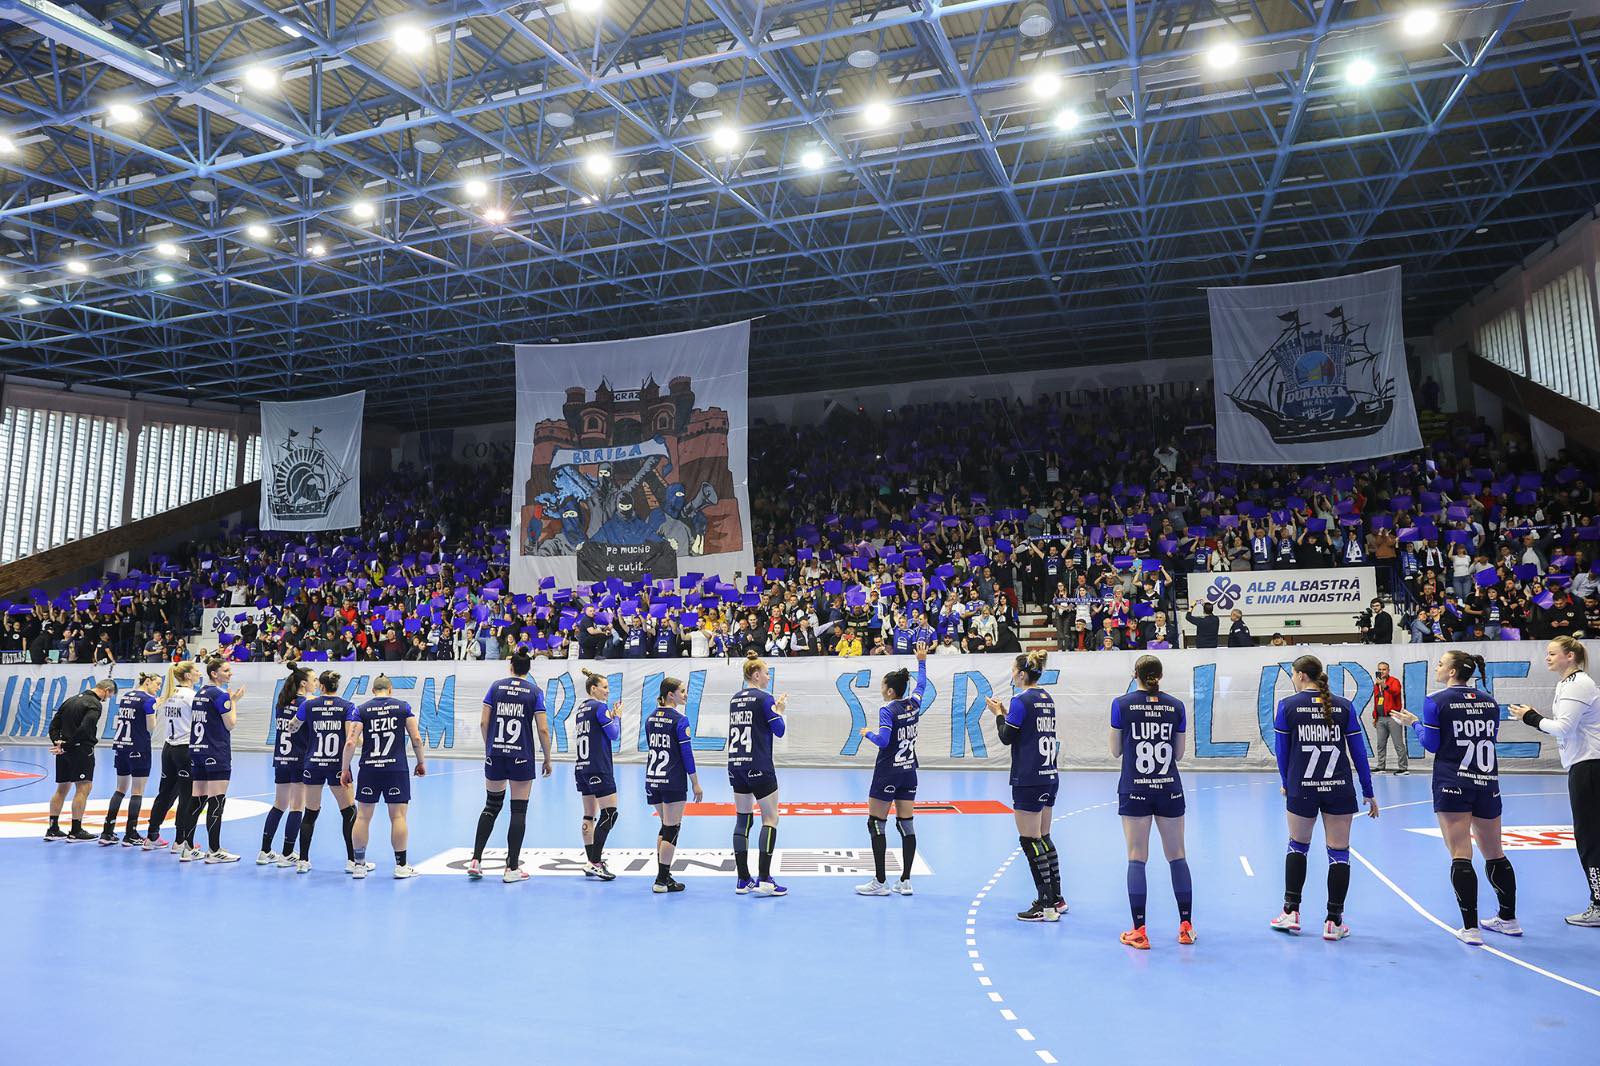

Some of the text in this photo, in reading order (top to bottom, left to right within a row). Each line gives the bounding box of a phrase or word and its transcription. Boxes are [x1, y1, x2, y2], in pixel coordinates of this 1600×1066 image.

[615, 392, 641, 401] GRAZ
[606, 563, 615, 572] de
[1246, 577, 1360, 593] ALB ALBASTRĂ
[1245, 590, 1361, 605] E INIMA NOASTRĂ
[496, 702, 525, 718] KANAVAL
[168, 719, 175, 740] 1
[193, 722, 205, 745] 9
[313, 720, 341, 733] QUINTINO
[368, 717, 398, 733] JEZIC
[494, 717, 522, 744] 19
[1131, 722, 1173, 741] LUPEI
[1298, 724, 1341, 742] MOHAMED
[1452, 719, 1495, 738] POPA
[279, 732, 293, 756] 5
[313, 732, 340, 758] 10
[370, 731, 396, 757] 17
[729, 726, 752, 754] 24
[647, 750, 670, 776] 22
[1135, 741, 1173, 775] 89
[1301, 745, 1341, 779] 77
[1456, 739, 1495, 773] 70
[1589, 867, 1600, 900] adidas
